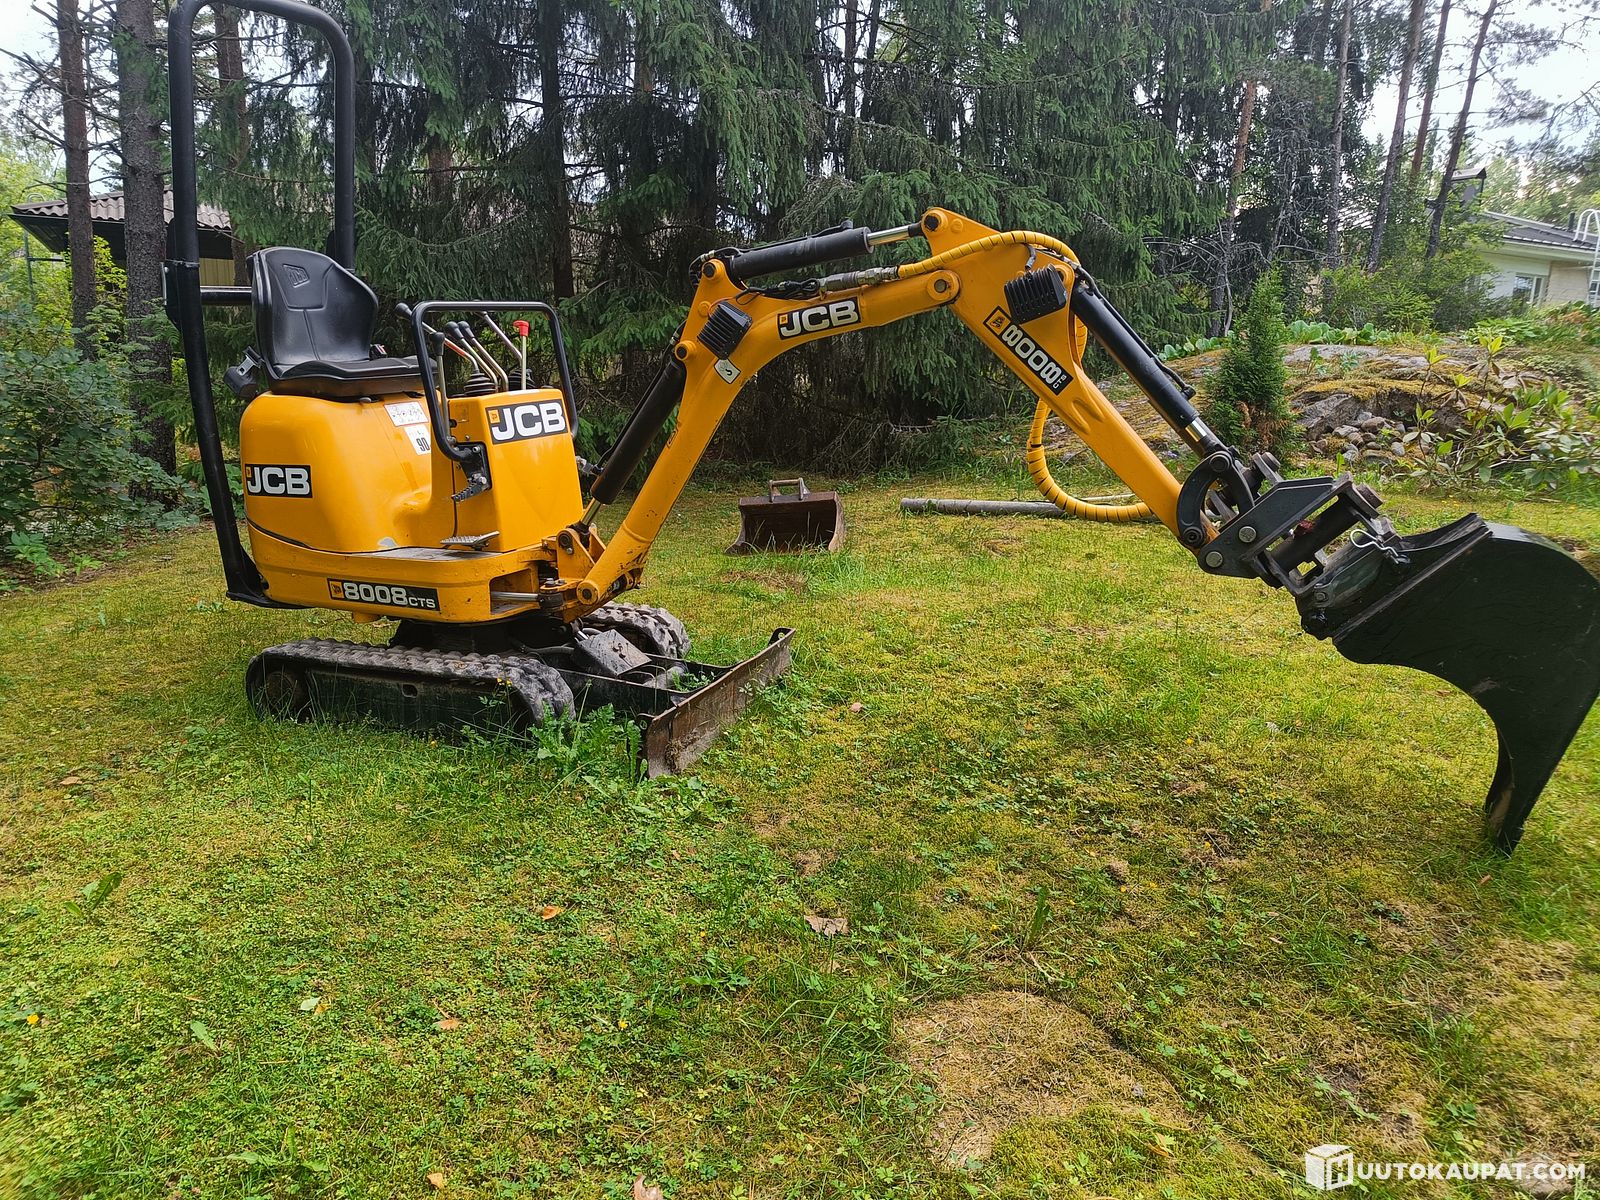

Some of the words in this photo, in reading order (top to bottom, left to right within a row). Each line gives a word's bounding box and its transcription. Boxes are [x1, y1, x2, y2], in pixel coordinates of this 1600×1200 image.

[780, 300, 858, 337] JCB
[1001, 324, 1062, 384] 8008
[491, 402, 566, 440] JCB
[247, 466, 310, 495] JCB
